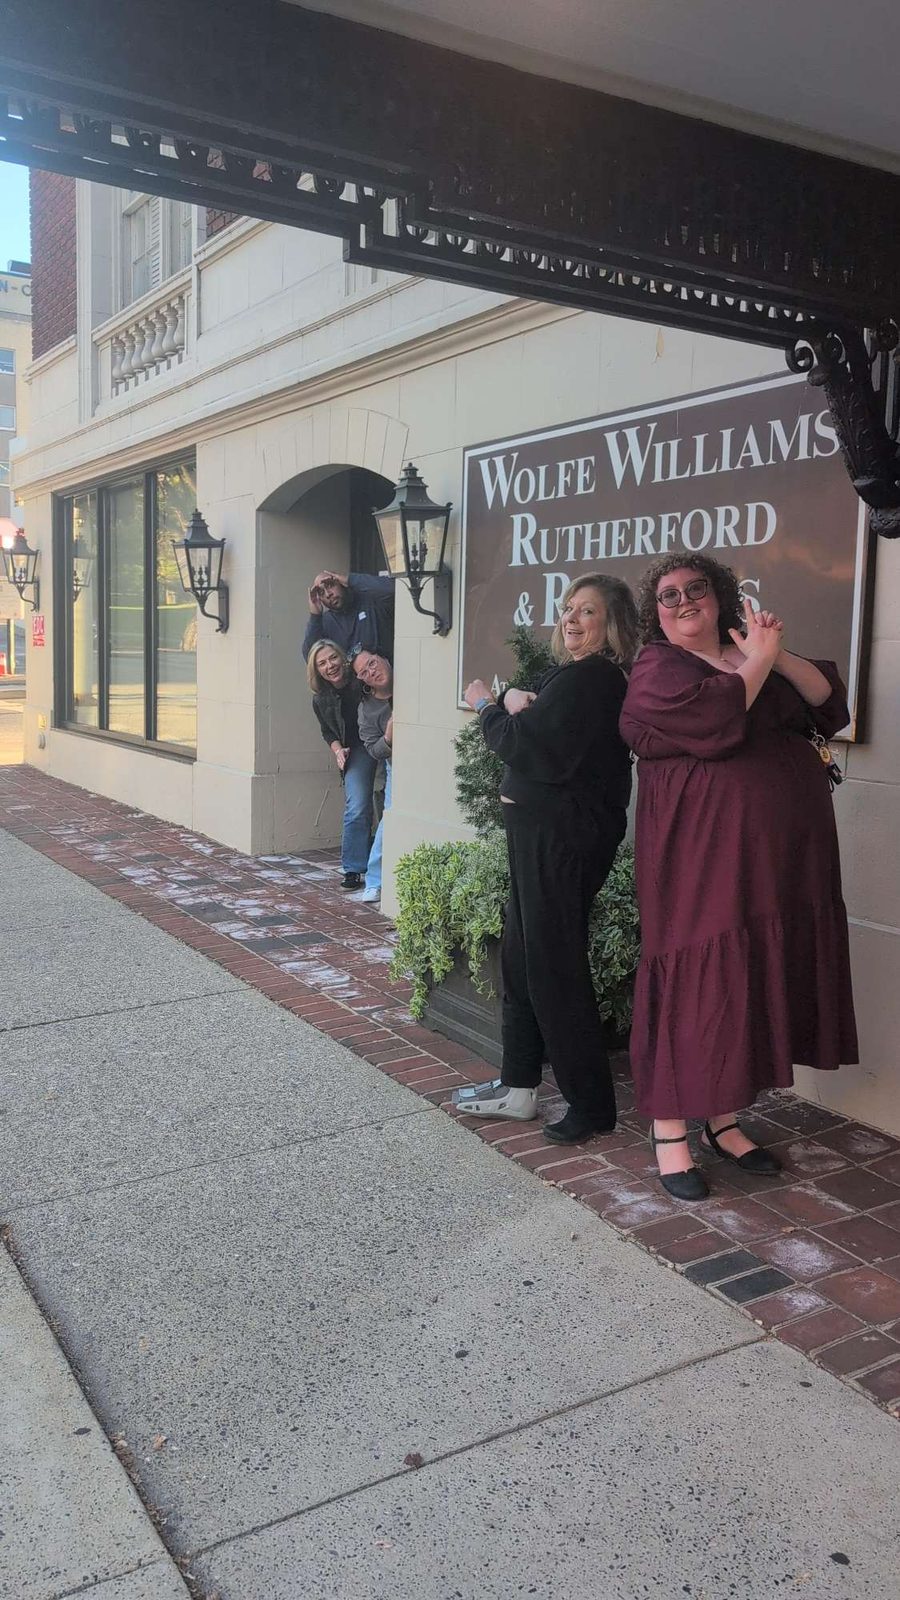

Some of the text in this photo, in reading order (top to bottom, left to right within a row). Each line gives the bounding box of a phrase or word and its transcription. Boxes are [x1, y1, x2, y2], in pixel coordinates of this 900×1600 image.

[479, 410, 840, 509] WOLFE WILLIAMS
[508, 502, 776, 566] RUTHERFORD
[514, 592, 535, 626] &
